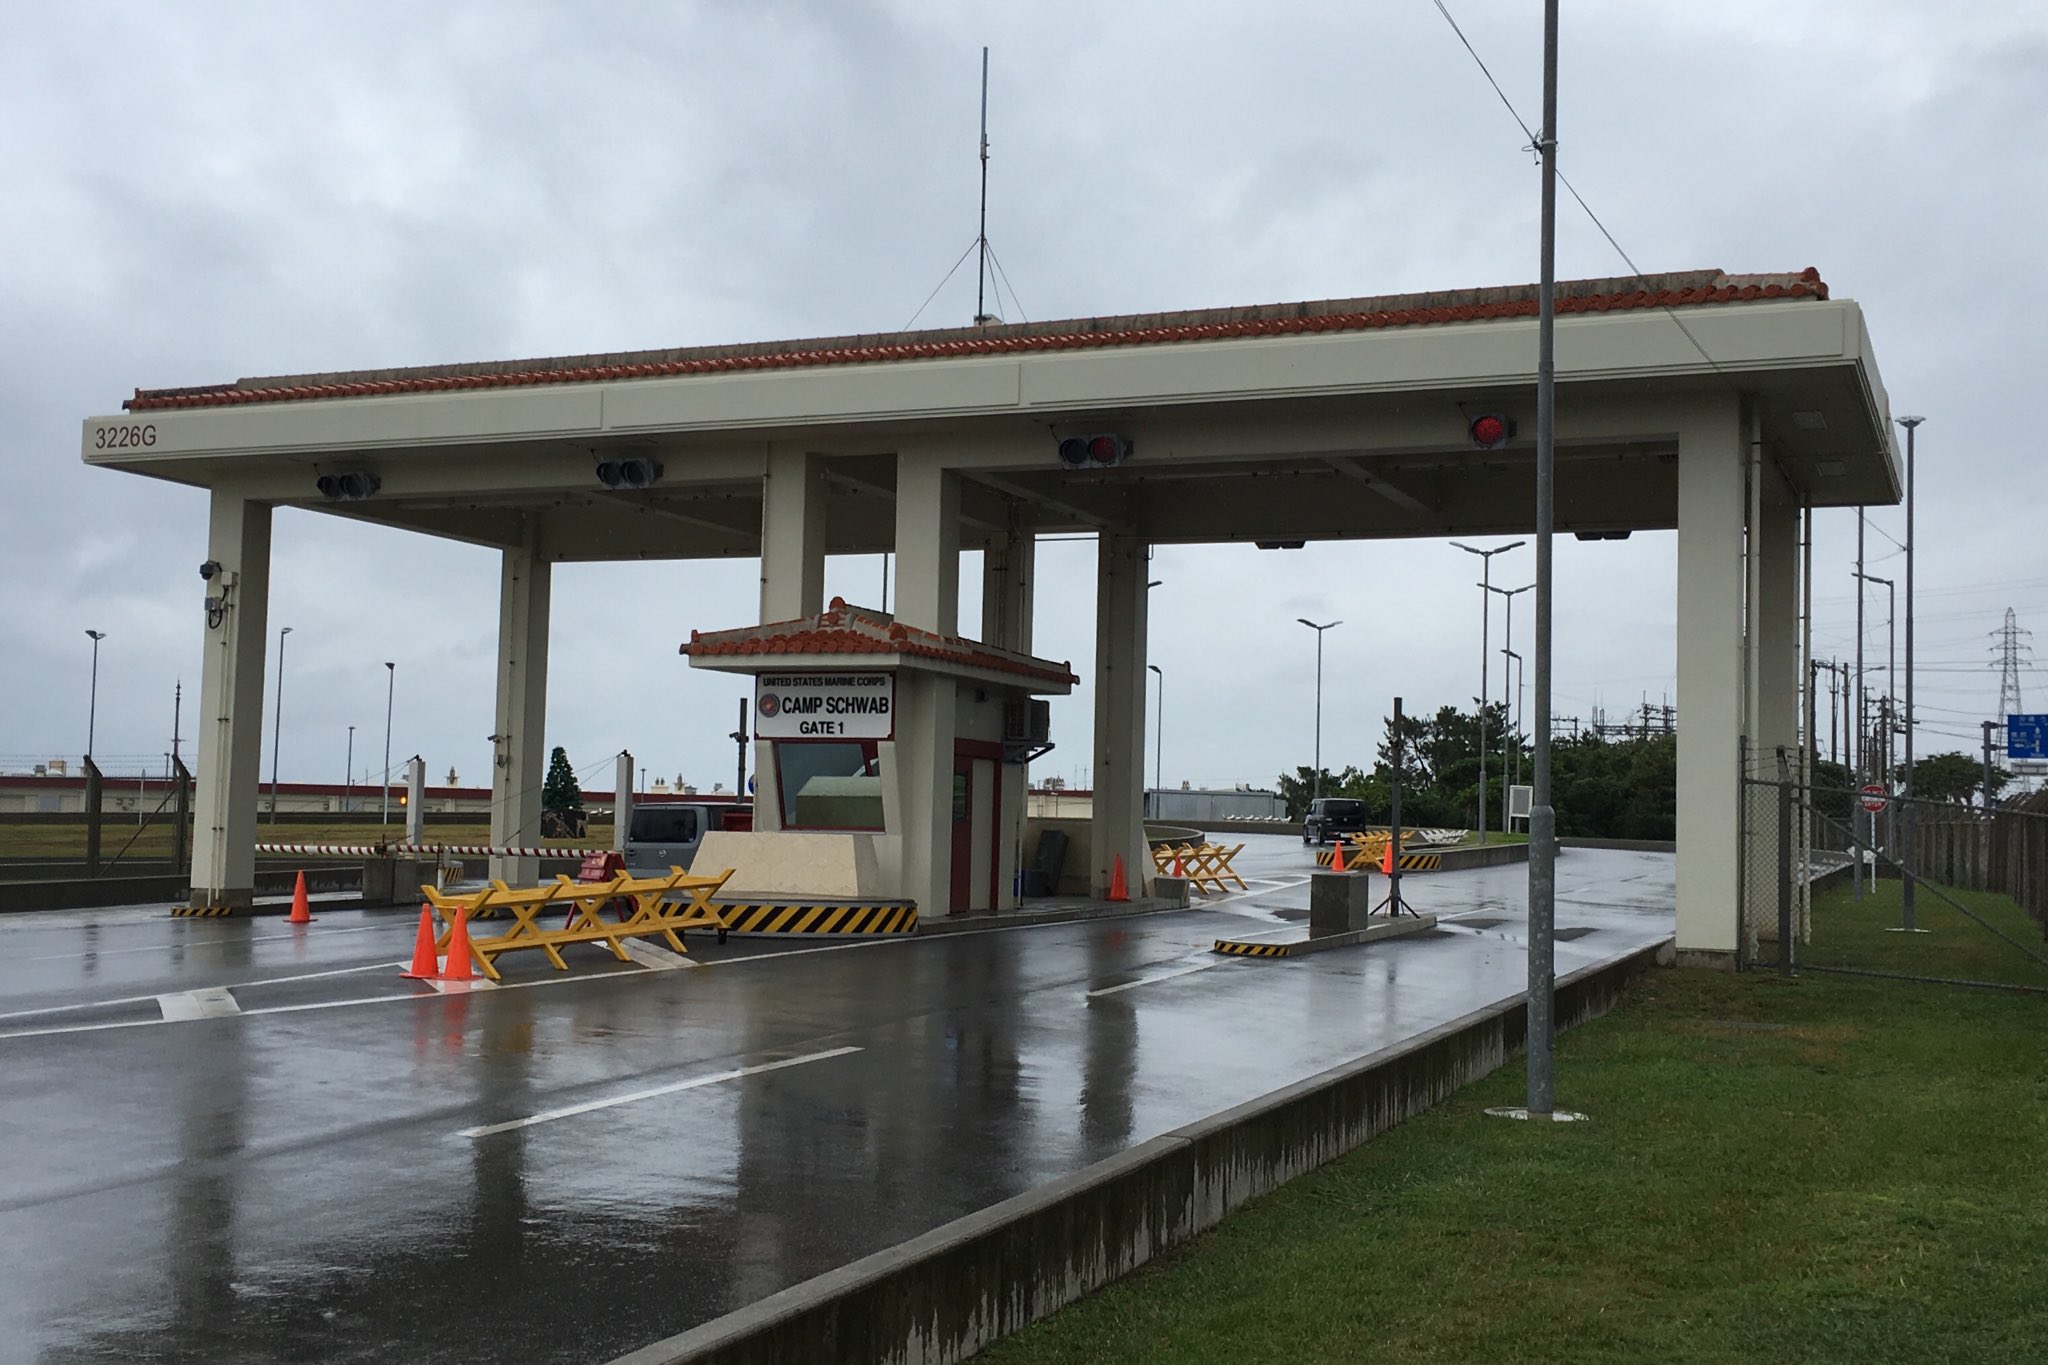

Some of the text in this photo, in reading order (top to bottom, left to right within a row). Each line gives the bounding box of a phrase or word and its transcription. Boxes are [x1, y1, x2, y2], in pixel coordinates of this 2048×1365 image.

[95, 424, 157, 449] 3226G
[763, 677, 885, 687] UNITED STATES MARINE CORPS
[782, 696, 822, 714] CAMP
[826, 696, 889, 714] SCHWAB
[800, 721, 844, 735] GATE 1
